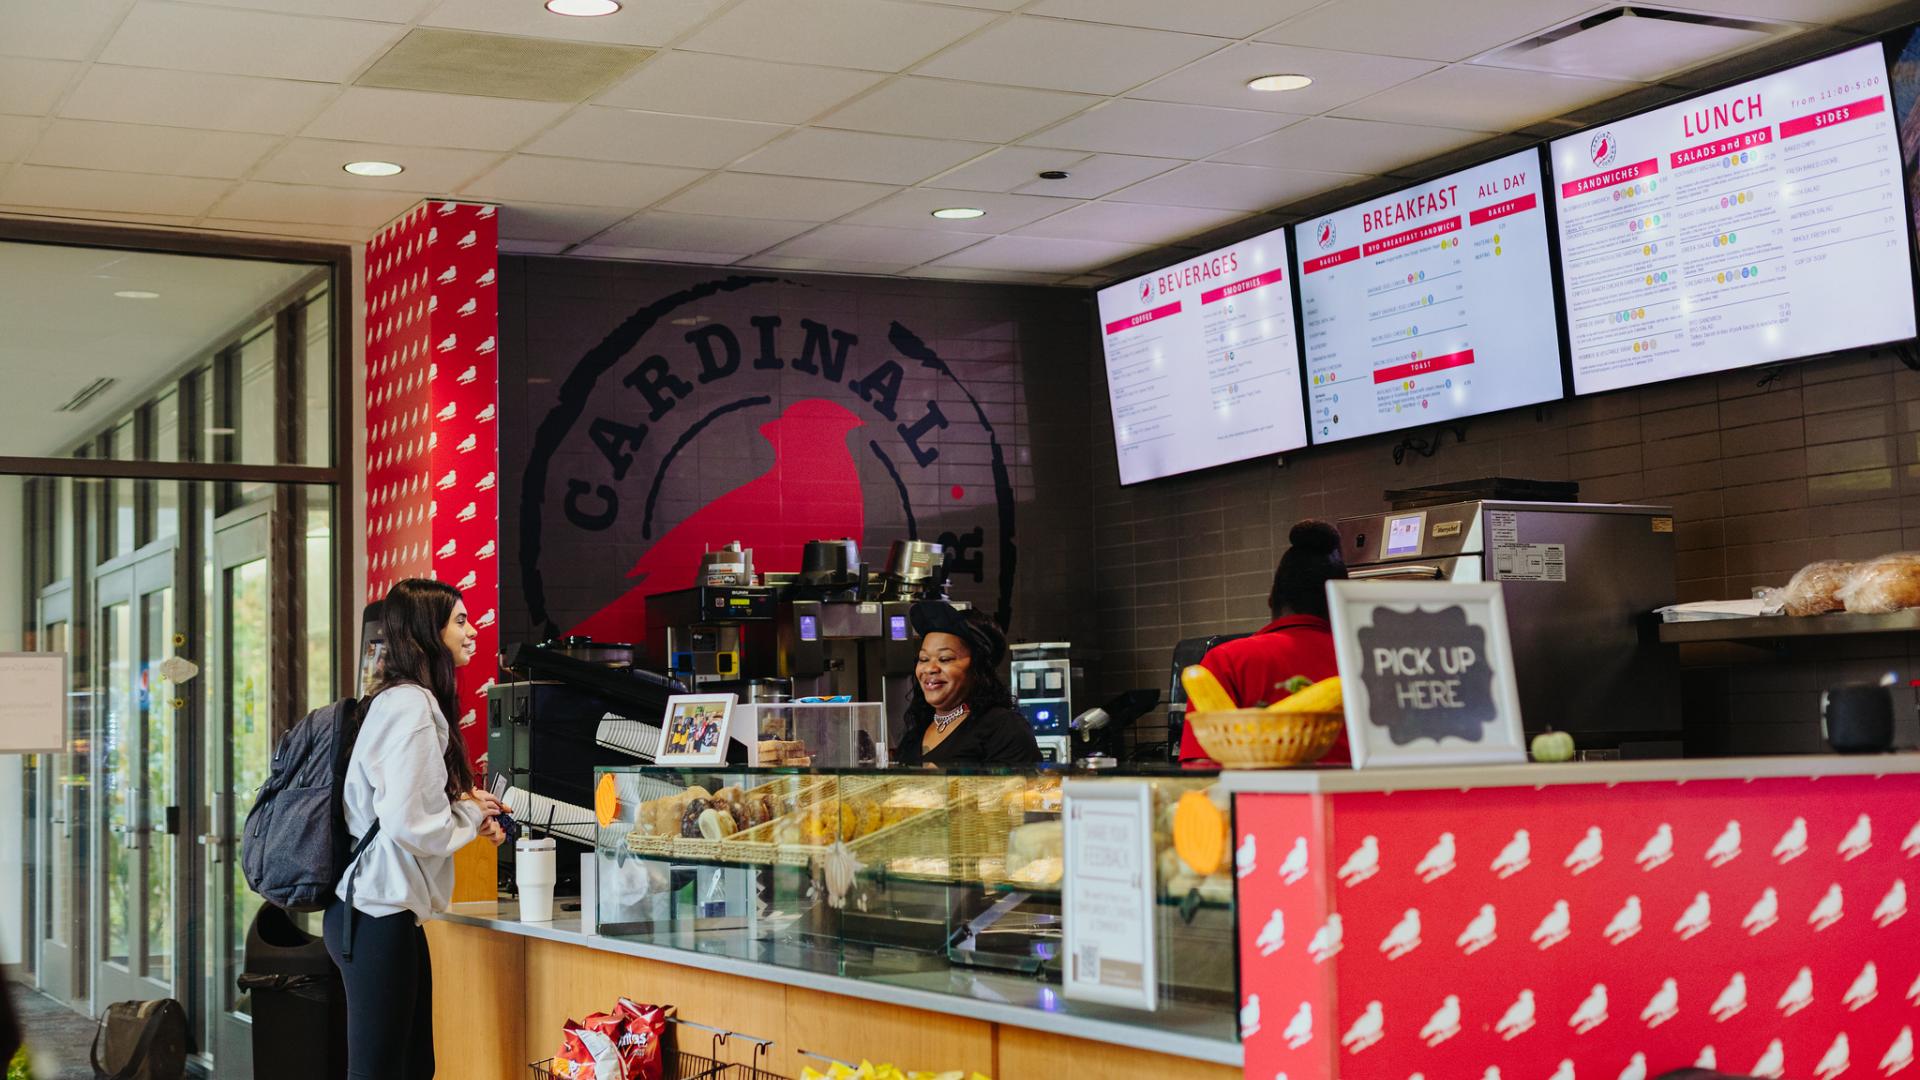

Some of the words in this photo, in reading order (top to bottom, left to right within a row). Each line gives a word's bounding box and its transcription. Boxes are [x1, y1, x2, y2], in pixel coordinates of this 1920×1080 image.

[1684, 93, 1764, 139] LUNCH
[1791, 96, 1816, 109] from
[1815, 107, 1850, 127] SIDES
[1677, 146, 1717, 164] SALADS
[1720, 138, 1740, 152] and
[1745, 131, 1766, 146] BYO
[1478, 182, 1499, 199] ALL
[1504, 172, 1526, 191] DAY
[1577, 166, 1639, 192] SANDWICHES
[1363, 185, 1458, 233] BREAKFAST
[1382, 231, 1418, 250] BREAKFAST
[1420, 222, 1455, 239] SANDWICH
[1158, 251, 1239, 296] BEVERAGES
[1223, 277, 1261, 297] SMOOTHIES
[1131, 311, 1153, 326] COFFEE
[1410, 360, 1431, 372] TOAST
[564, 315, 950, 532] CARDINAL
[1373, 646, 1435, 677] PICK
[1438, 645, 1477, 675] UP
[1395, 679, 1466, 710] HERE
